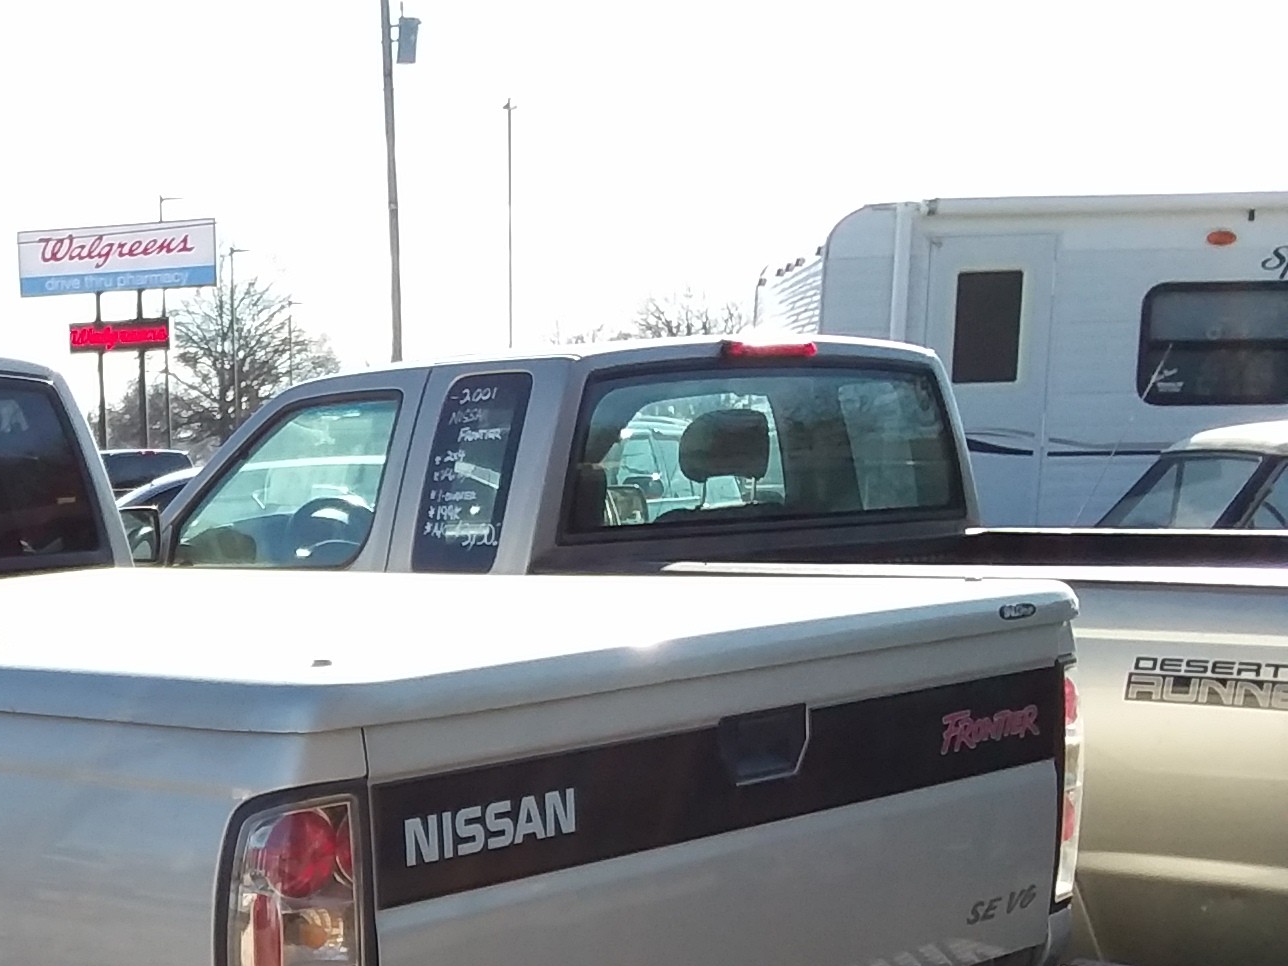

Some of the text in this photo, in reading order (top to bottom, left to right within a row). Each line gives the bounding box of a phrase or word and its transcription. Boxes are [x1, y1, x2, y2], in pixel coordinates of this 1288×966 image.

[38, 234, 196, 269] Walgreens
[45, 271, 189, 291] drive thru pharmacy
[1133, 656, 1288, 679] DESERT
[941, 704, 1040, 755] FRONTIER
[404, 788, 576, 867] NISSAN
[966, 884, 1037, 925] SE V6
